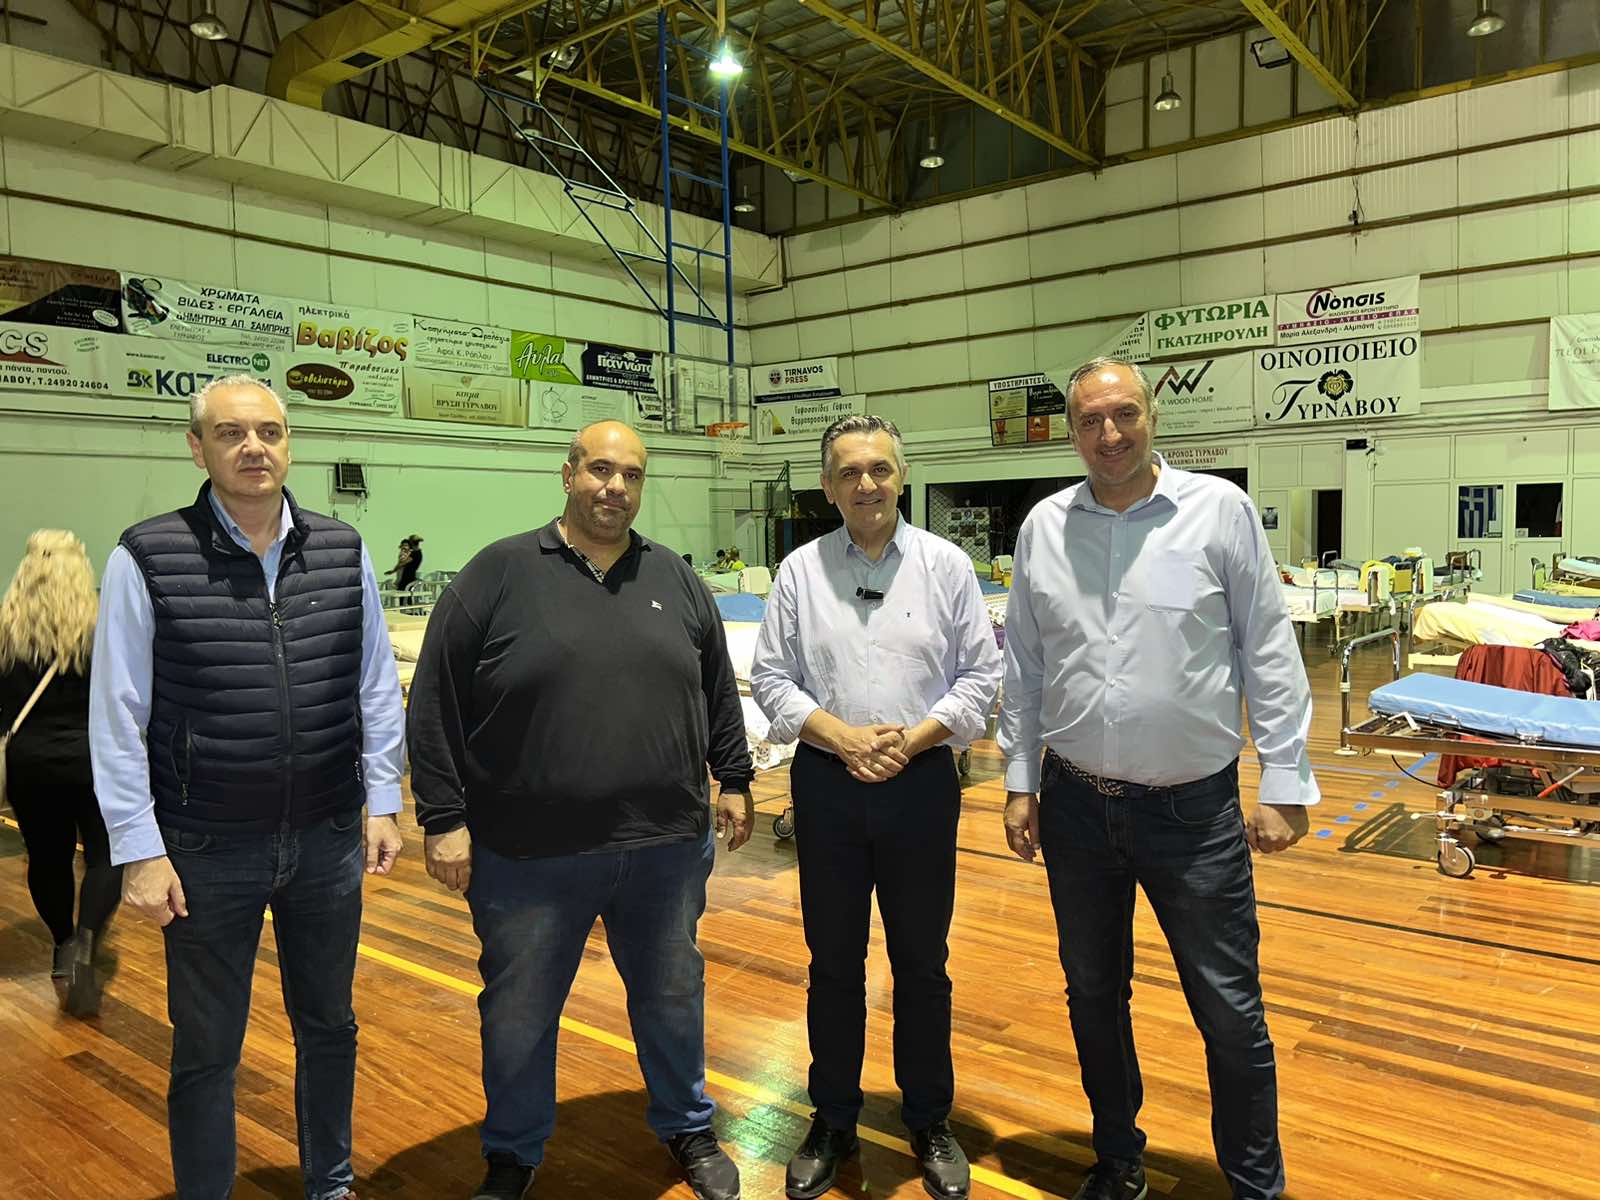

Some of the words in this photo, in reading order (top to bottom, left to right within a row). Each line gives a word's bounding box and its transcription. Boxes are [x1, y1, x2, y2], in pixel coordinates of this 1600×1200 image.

[200, 288, 261, 305] ΧΡΩΜΑΤΑ
[177, 297, 215, 311] ΒΙΔΕΣ
[227, 304, 284, 321] ΕΡΓΑΛΕΙΑ
[1154, 300, 1270, 330] ΦΥΤΩΡΙΑ
[250, 321, 292, 335] ΣΑΜΠΡΗΣ
[1157, 326, 1268, 350] ΓΚΑΤΖΗΡΟΥΛΗ
[296, 321, 409, 361] Βαβίζος
[206, 353, 251, 366] ELECTRO
[1260, 337, 1417, 371] ΟΙΝΟΠΟΙΕΙΟ
[784, 365, 823, 377] TIRNAVOS
[785, 375, 809, 384] PRESS
[80, 379, 109, 390] 24604
[1265, 378, 1401, 422] ΤΥΡΝΑΒΟΥ
